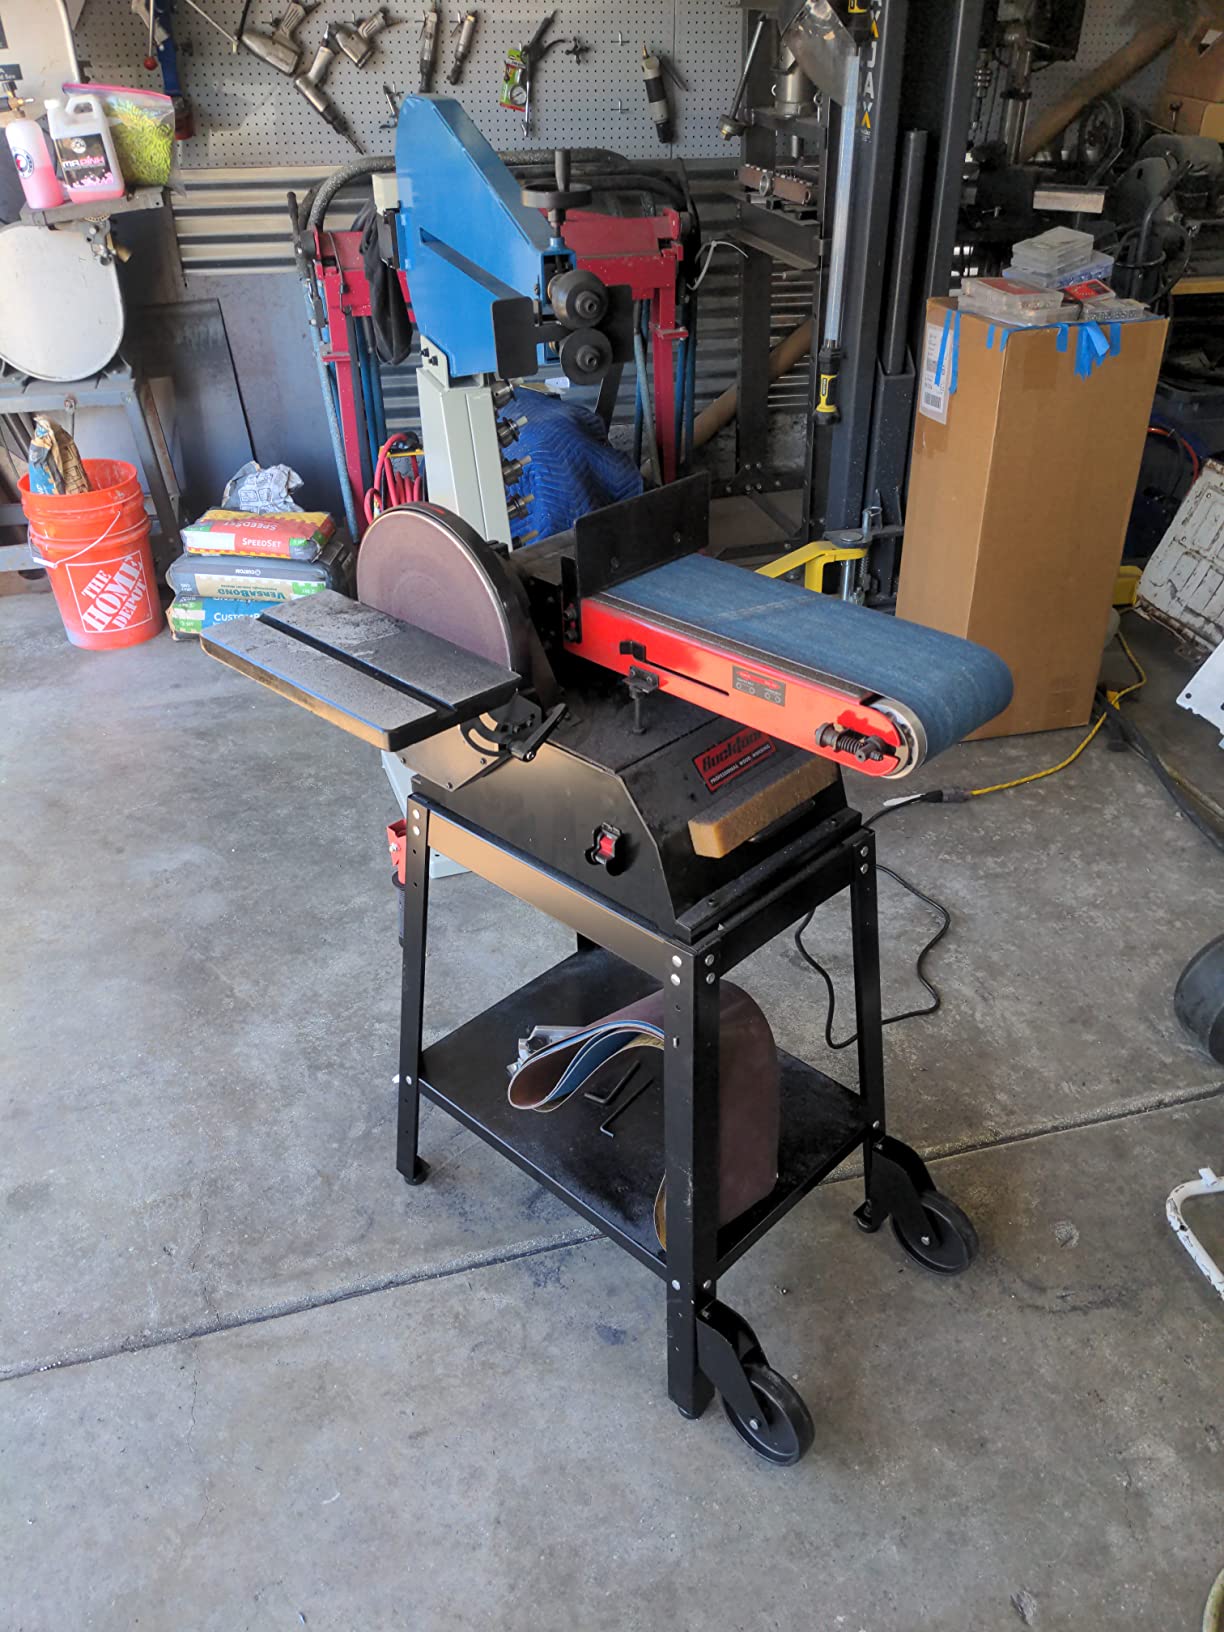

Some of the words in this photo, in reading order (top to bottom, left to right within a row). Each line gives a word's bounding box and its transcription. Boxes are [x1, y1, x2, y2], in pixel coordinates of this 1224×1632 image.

[81, 569, 112, 599] THE
[82, 555, 143, 631] HOME
[112, 578, 146, 628] DEPOT
